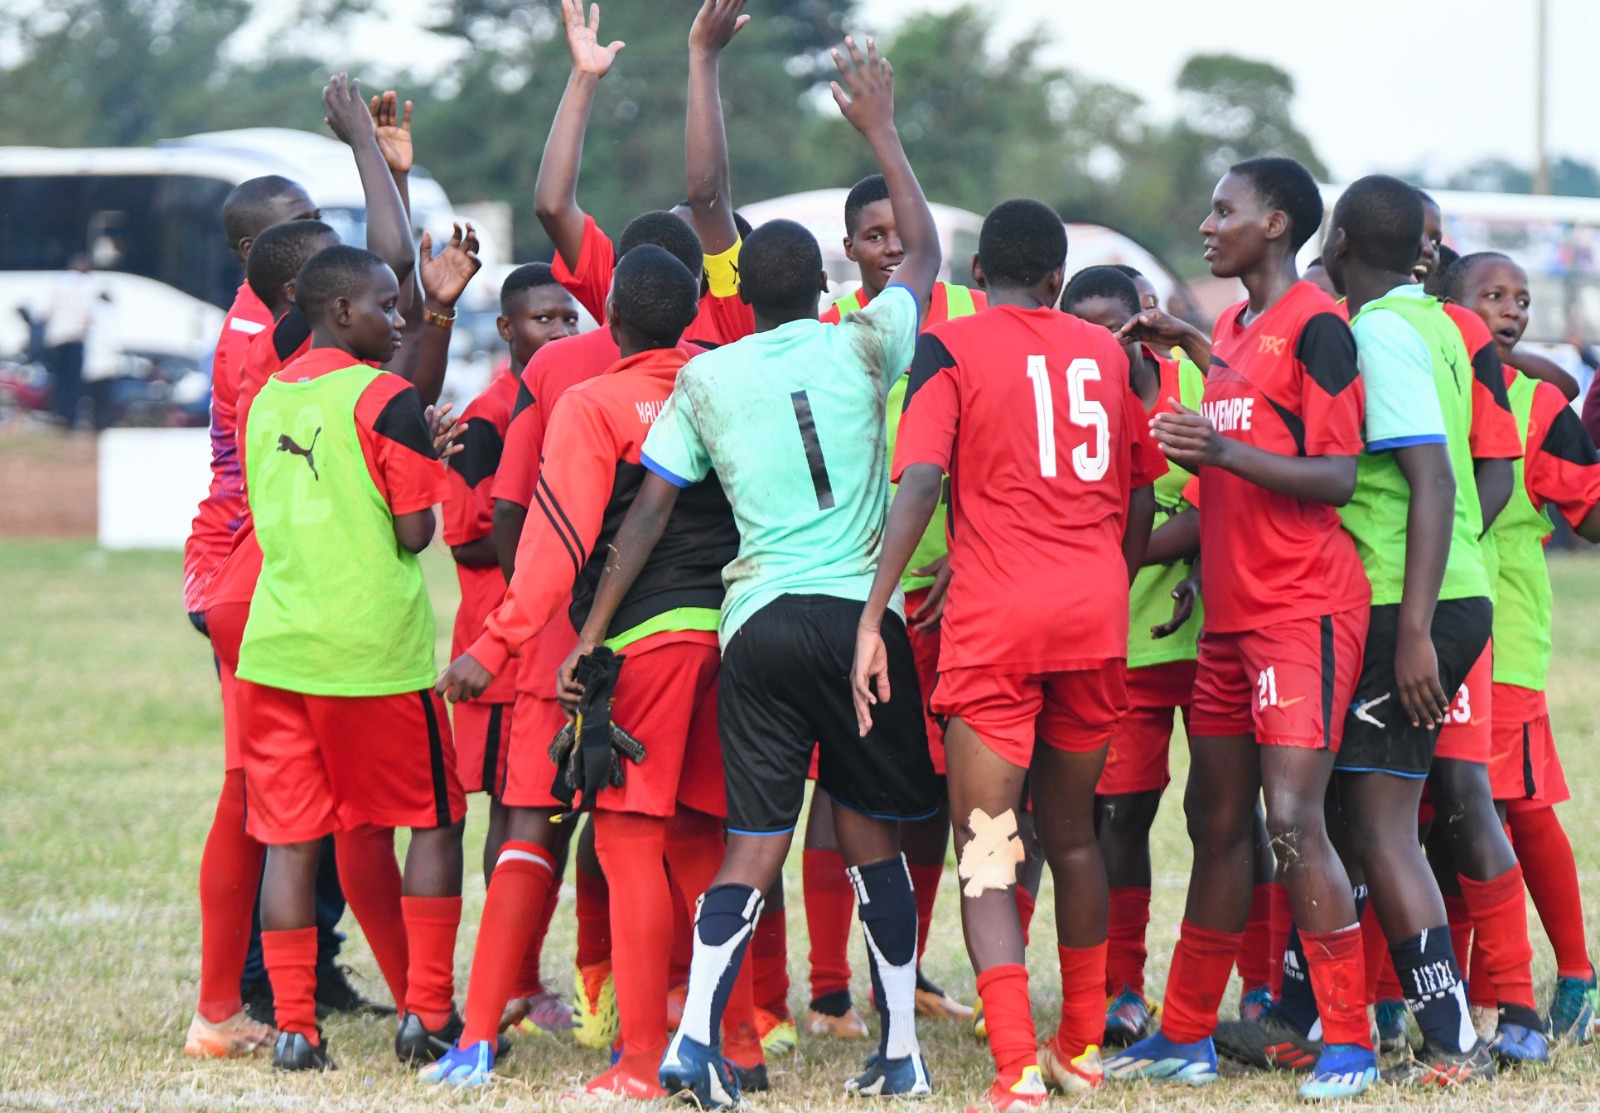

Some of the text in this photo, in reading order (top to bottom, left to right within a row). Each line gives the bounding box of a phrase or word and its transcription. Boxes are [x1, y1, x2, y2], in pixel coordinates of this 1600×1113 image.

[1026, 354, 1110, 481] 15
[1200, 397, 1255, 432] WEMPE
[790, 389, 835, 511] 1
[1257, 665, 1278, 711] 21
[1443, 682, 1471, 723] 3
